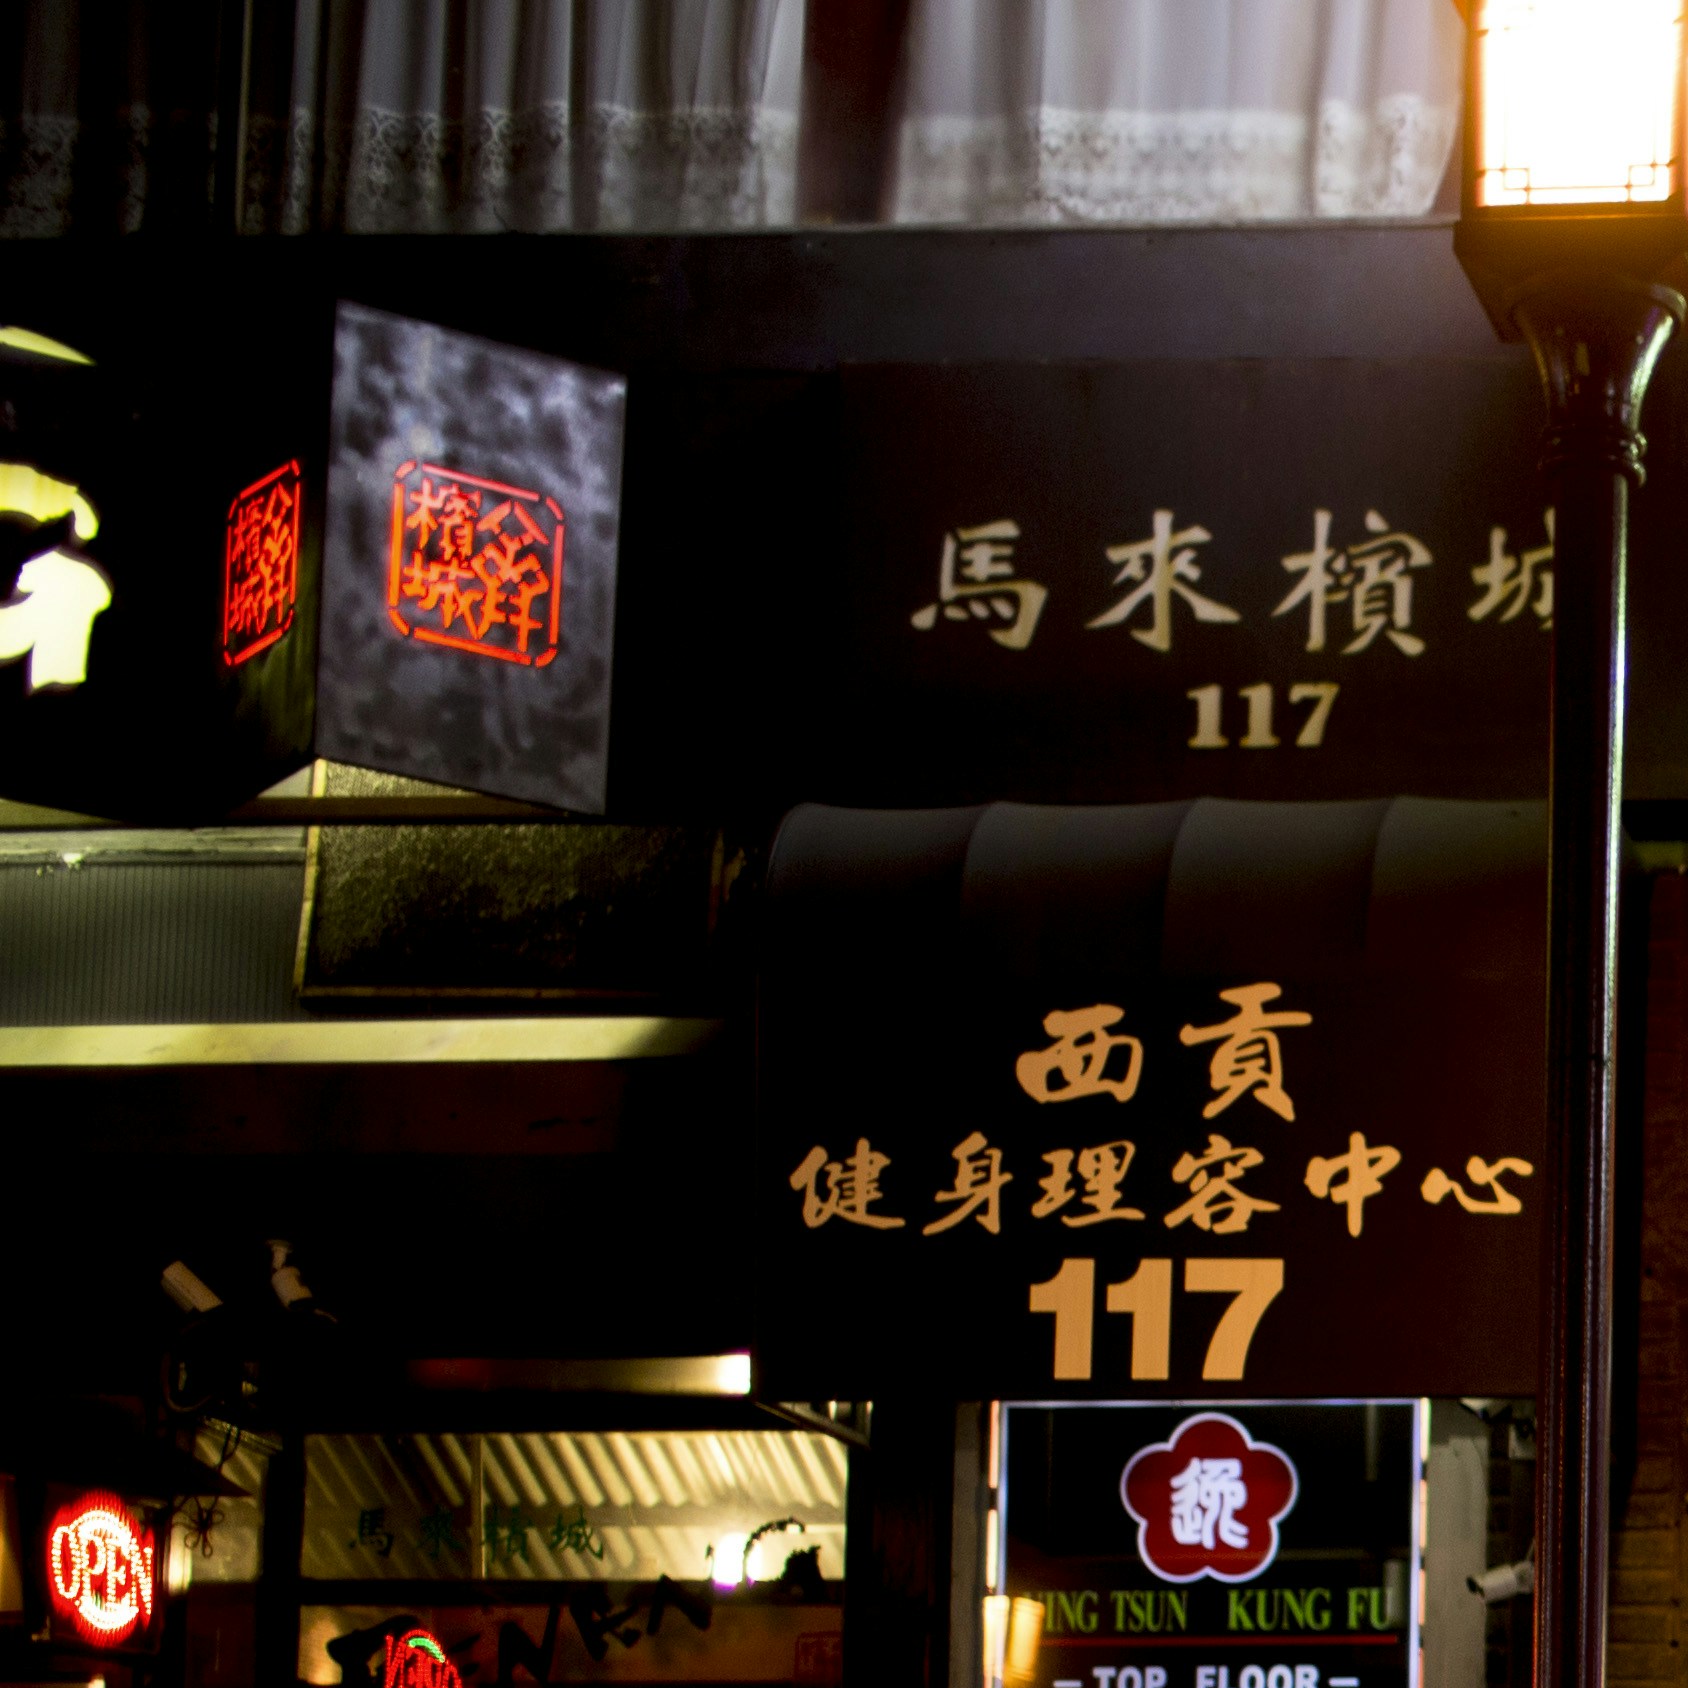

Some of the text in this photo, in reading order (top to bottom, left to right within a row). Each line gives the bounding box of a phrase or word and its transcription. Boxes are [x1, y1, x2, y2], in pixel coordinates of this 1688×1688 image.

[1187, 683, 1340, 748] 117
[1016, 982, 1313, 1122] 西貢
[790, 1130, 1534, 1238] 健身理容中心
[1029, 1258, 1285, 1381] 117
[52, 1522, 153, 1616] OPEN
[1024, 1588, 1393, 1633] ING TSUN KUNG FU
